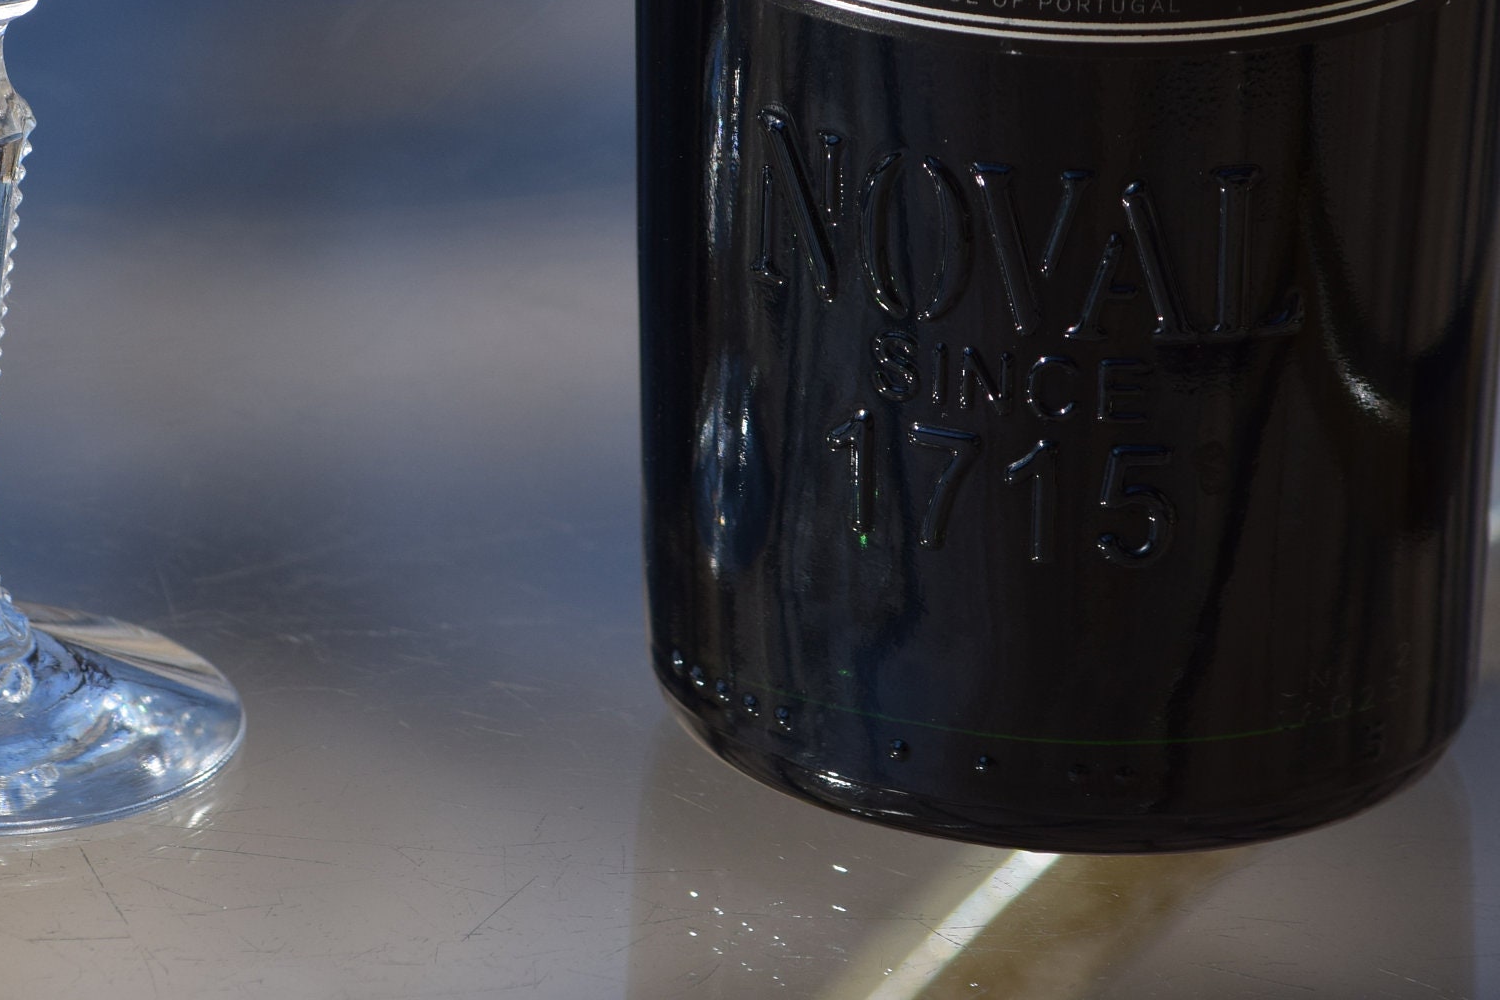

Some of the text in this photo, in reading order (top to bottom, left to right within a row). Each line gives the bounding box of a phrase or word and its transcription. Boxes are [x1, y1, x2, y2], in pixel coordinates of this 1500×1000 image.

[751, 104, 1303, 339] NOVAL
[870, 330, 1154, 424] SINCE
[825, 407, 1179, 567] 1715
